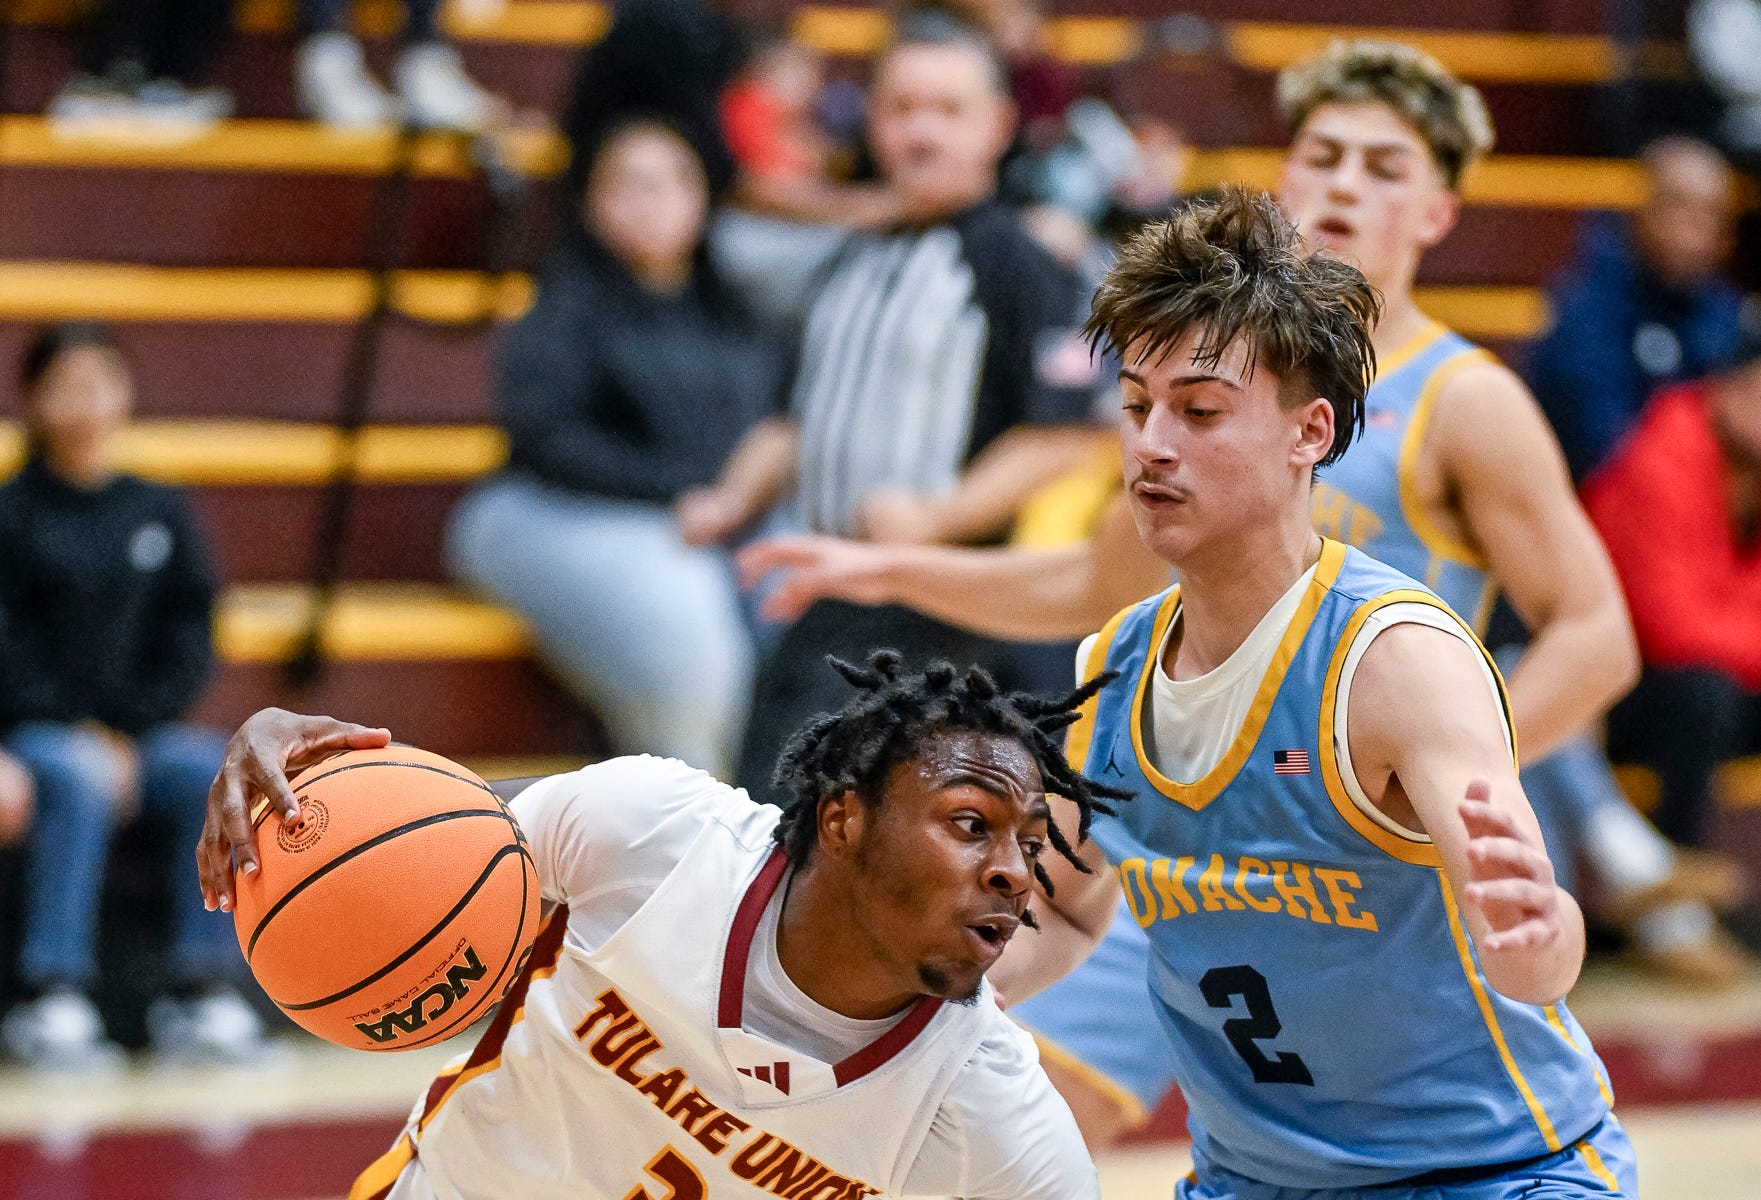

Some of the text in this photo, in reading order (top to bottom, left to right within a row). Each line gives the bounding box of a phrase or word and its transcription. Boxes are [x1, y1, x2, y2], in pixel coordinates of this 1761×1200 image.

[1113, 853, 1379, 932] ONACHE
[345, 937, 467, 1022] OFFICIAL GAME BALL
[353, 944, 488, 1043] NCAA
[1198, 964, 1315, 1087] 2
[572, 987, 752, 1157] TULARE
